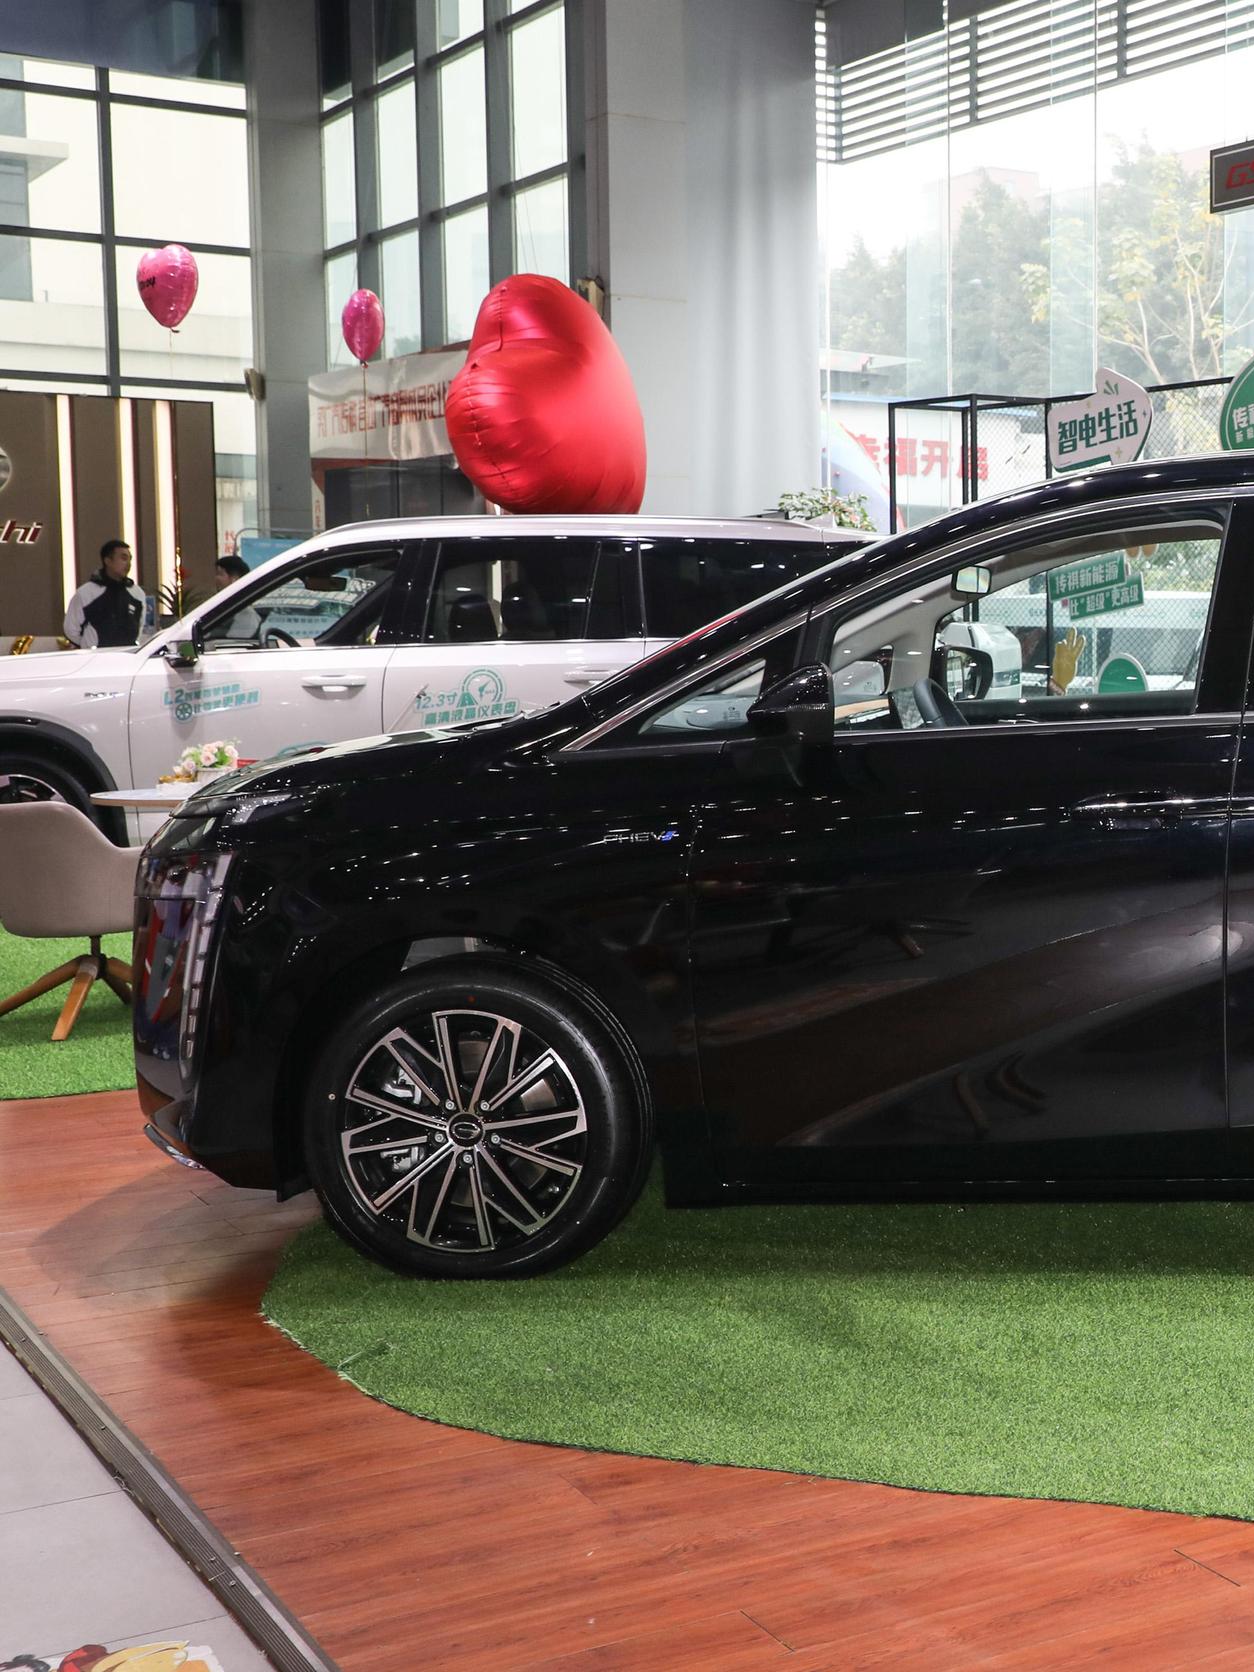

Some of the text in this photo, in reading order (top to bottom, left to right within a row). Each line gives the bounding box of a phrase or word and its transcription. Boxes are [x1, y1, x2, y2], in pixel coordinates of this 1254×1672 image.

[1058, 401, 1138, 454] 智电生活
[1056, 561, 1118, 594] 传祺新能源
